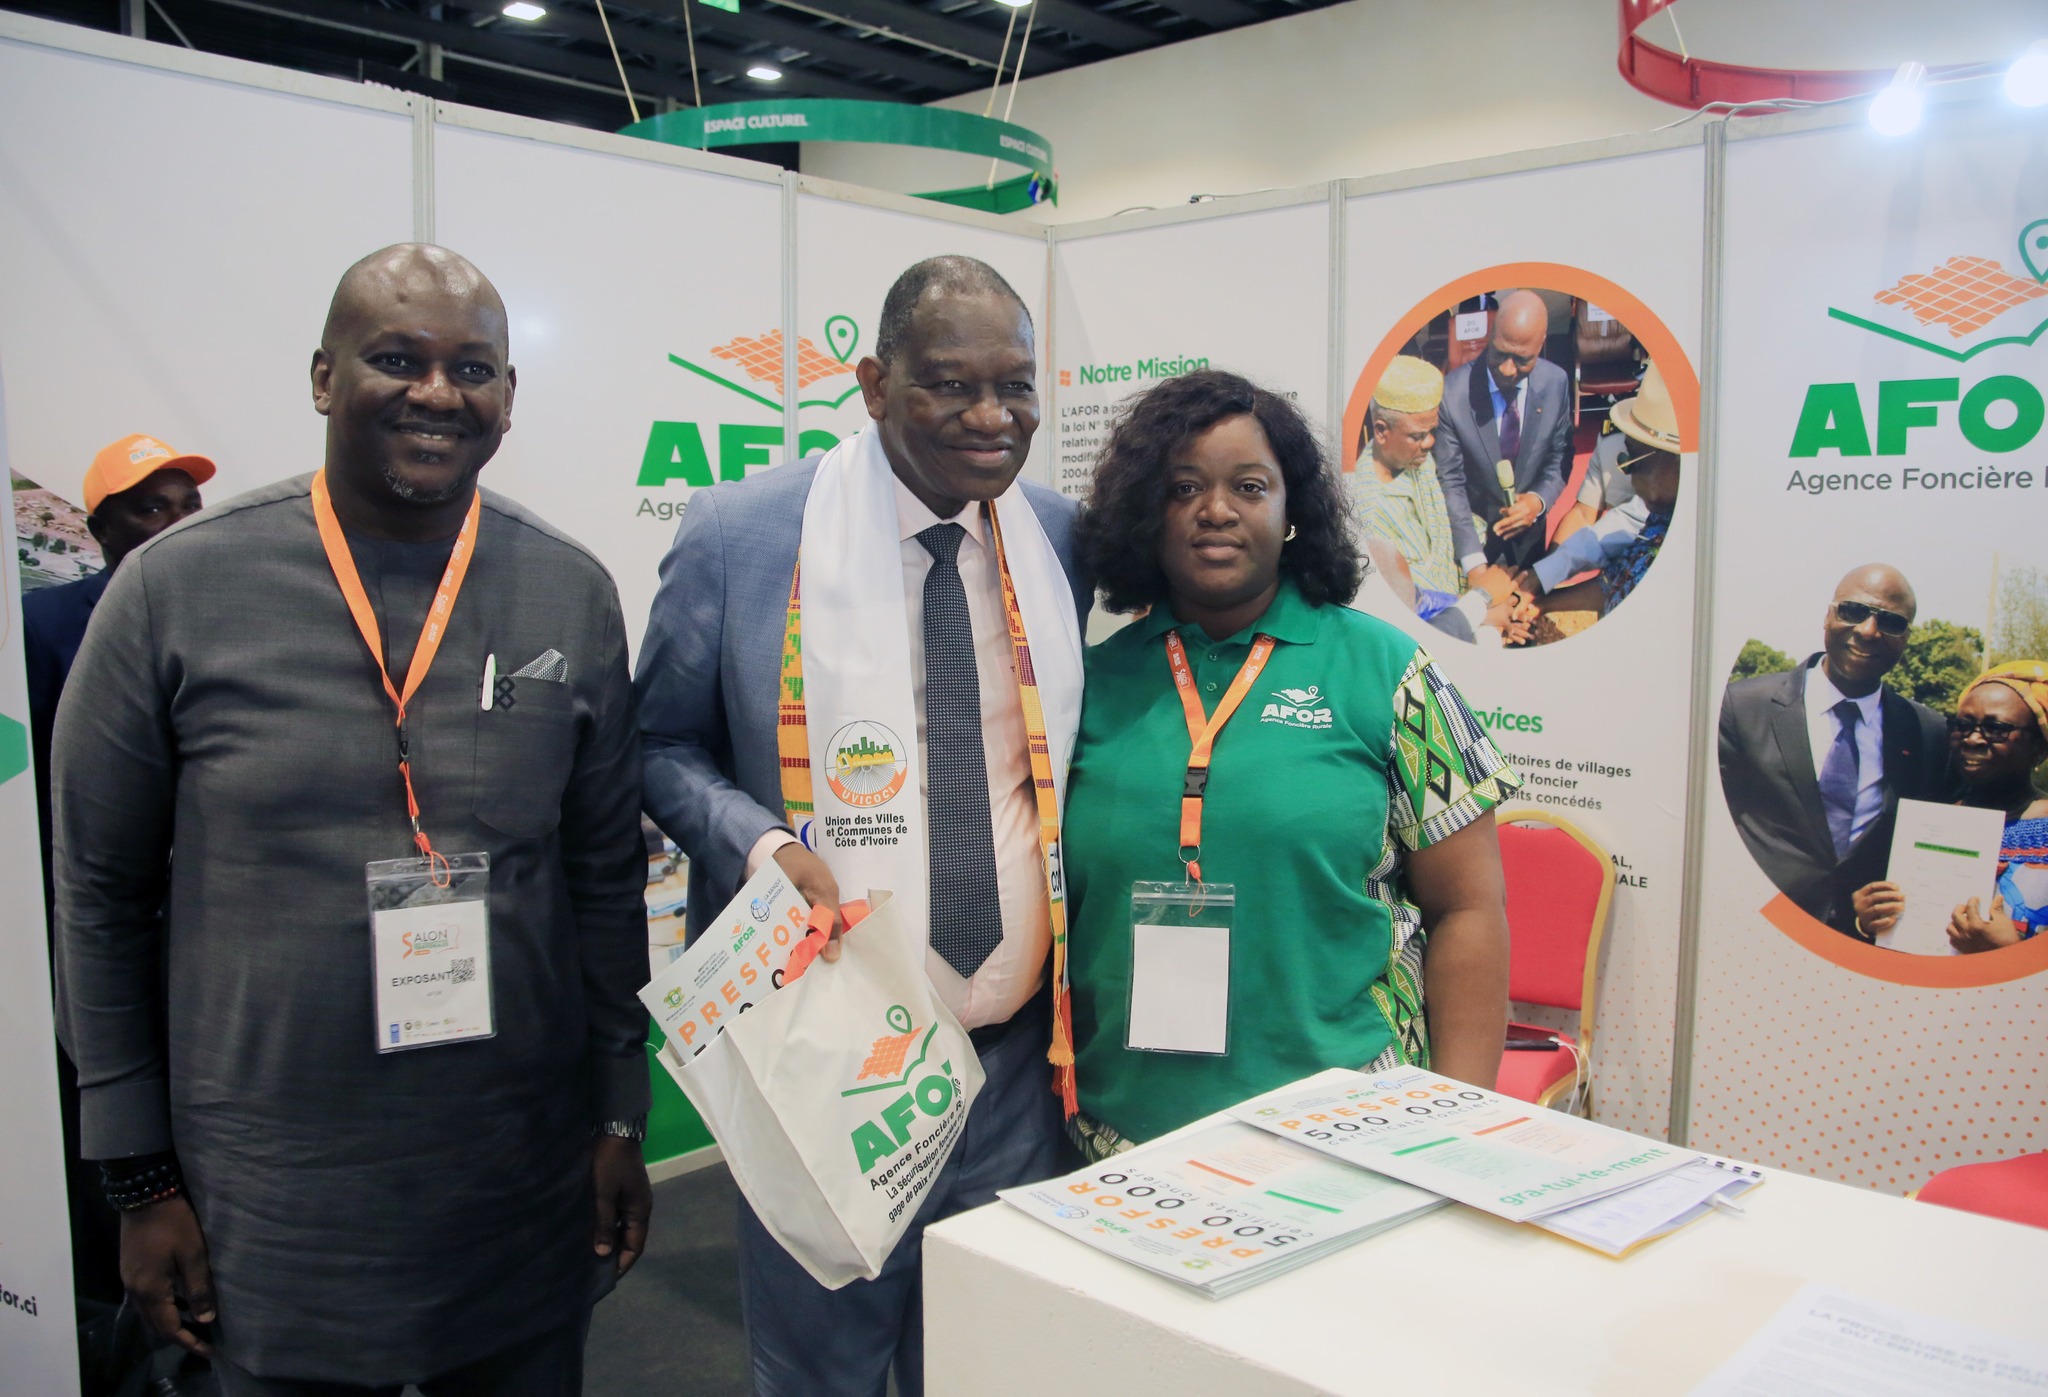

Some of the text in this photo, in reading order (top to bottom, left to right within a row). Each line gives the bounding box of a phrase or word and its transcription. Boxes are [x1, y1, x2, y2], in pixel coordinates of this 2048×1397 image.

[703, 114, 808, 133] ESPACE CULTUREL
[1080, 354, 1209, 385] Notre Mission
[1061, 405, 1100, 417] L'AFOR
[1102, 406, 1109, 415] a
[1061, 422, 1070, 433] la
[1073, 421, 1086, 432] loi
[1061, 437, 1099, 448] relative
[1062, 468, 1088, 479] 2004
[1786, 470, 1892, 495] Agence
[1902, 466, 2033, 491] Foncière
[1062, 485, 1072, 494] et
[636, 498, 687, 520] Age
[1260, 703, 1333, 724] AFOR
[1284, 720, 1311, 729] Foncière
[1555, 759, 1573, 771] de
[1577, 761, 1631, 778] villages
[1530, 773, 1578, 789] foncier
[841, 786, 896, 806] UVICOCI
[1536, 793, 1602, 810] concédés
[825, 814, 905, 826] Union des Villes
[826, 824, 908, 837] et Communes de
[835, 834, 898, 848] Côte d'Ivoire
[733, 926, 756, 953] AFOR
[391, 970, 453, 987] EXPOSANT
[678, 906, 805, 1046] PRESFOR
[851, 1059, 958, 1174] AFO
[1279, 1083, 1458, 1131] PRESFOR
[1305, 1091, 1484, 1140] 500 000
[1328, 1118, 1426, 1146] certificats
[1427, 1098, 1499, 1121] fonciers
[870, 1152, 913, 1190] Agence
[915, 1110, 955, 1154] Foncière
[886, 1186, 899, 1199] La
[897, 1144, 939, 1190] sécurisation
[1499, 1148, 1670, 1206] gra-tui-te-ment
[888, 1201, 905, 1223] gage
[905, 1189, 914, 1204] de
[912, 1176, 929, 1196] paix
[1126, 1167, 1202, 1201] fonciers
[1206, 1201, 1314, 1238] certificats
[1067, 1181, 1264, 1259] PRESFOR
[1098, 1173, 1185, 1209] 000
[1201, 1215, 1299, 1248] 500
[1095, 1217, 1131, 1234] AFOR
